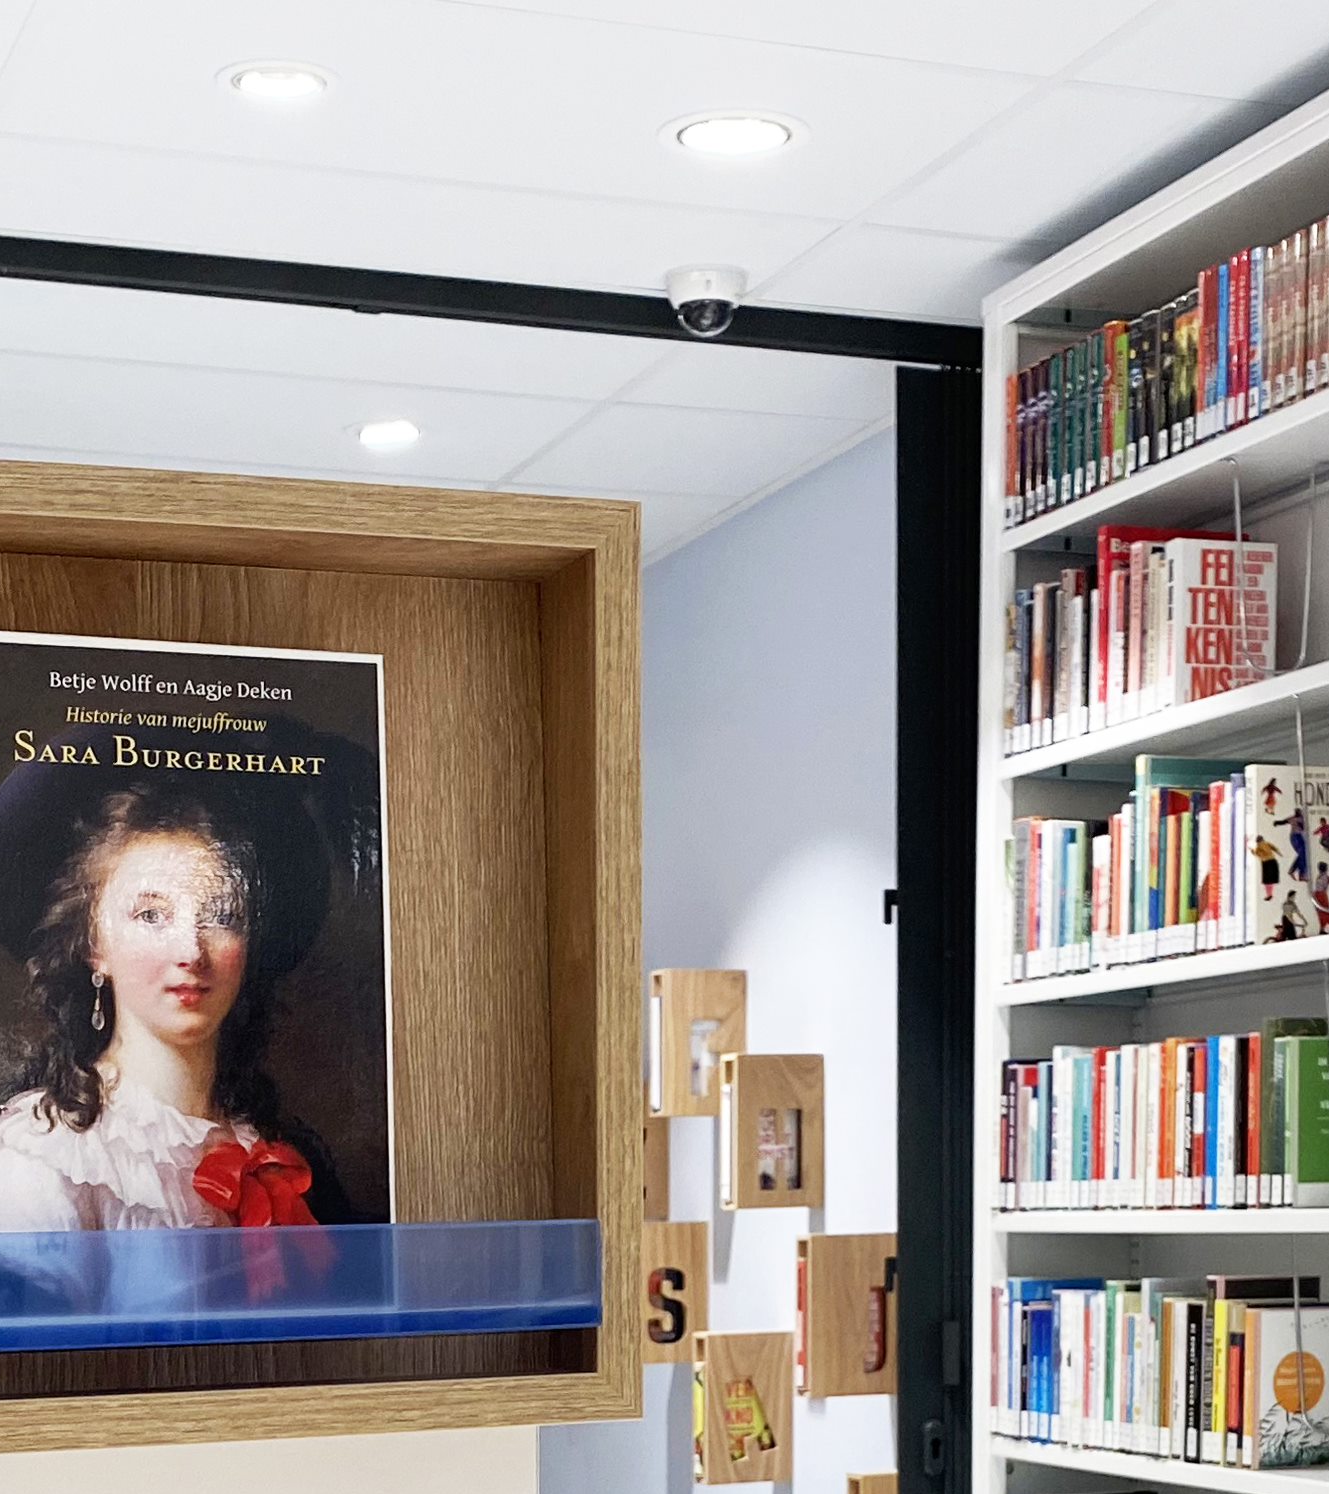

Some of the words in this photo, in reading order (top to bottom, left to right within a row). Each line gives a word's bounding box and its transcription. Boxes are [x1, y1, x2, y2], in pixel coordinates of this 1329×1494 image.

[1200, 548, 1237, 587] FE
[1187, 587, 1234, 626] TEN
[1184, 627, 1234, 664] KEN
[49, 671, 97, 694] Betje
[101, 674, 154, 693] Wolff
[156, 680, 178, 694] en
[183, 679, 232, 701] Aagje
[238, 682, 292, 701] Deken
[1191, 667, 1233, 702] NIS
[66, 706, 133, 725] Historie
[136, 711, 168, 727] van
[172, 711, 267, 733] mejuffrouw
